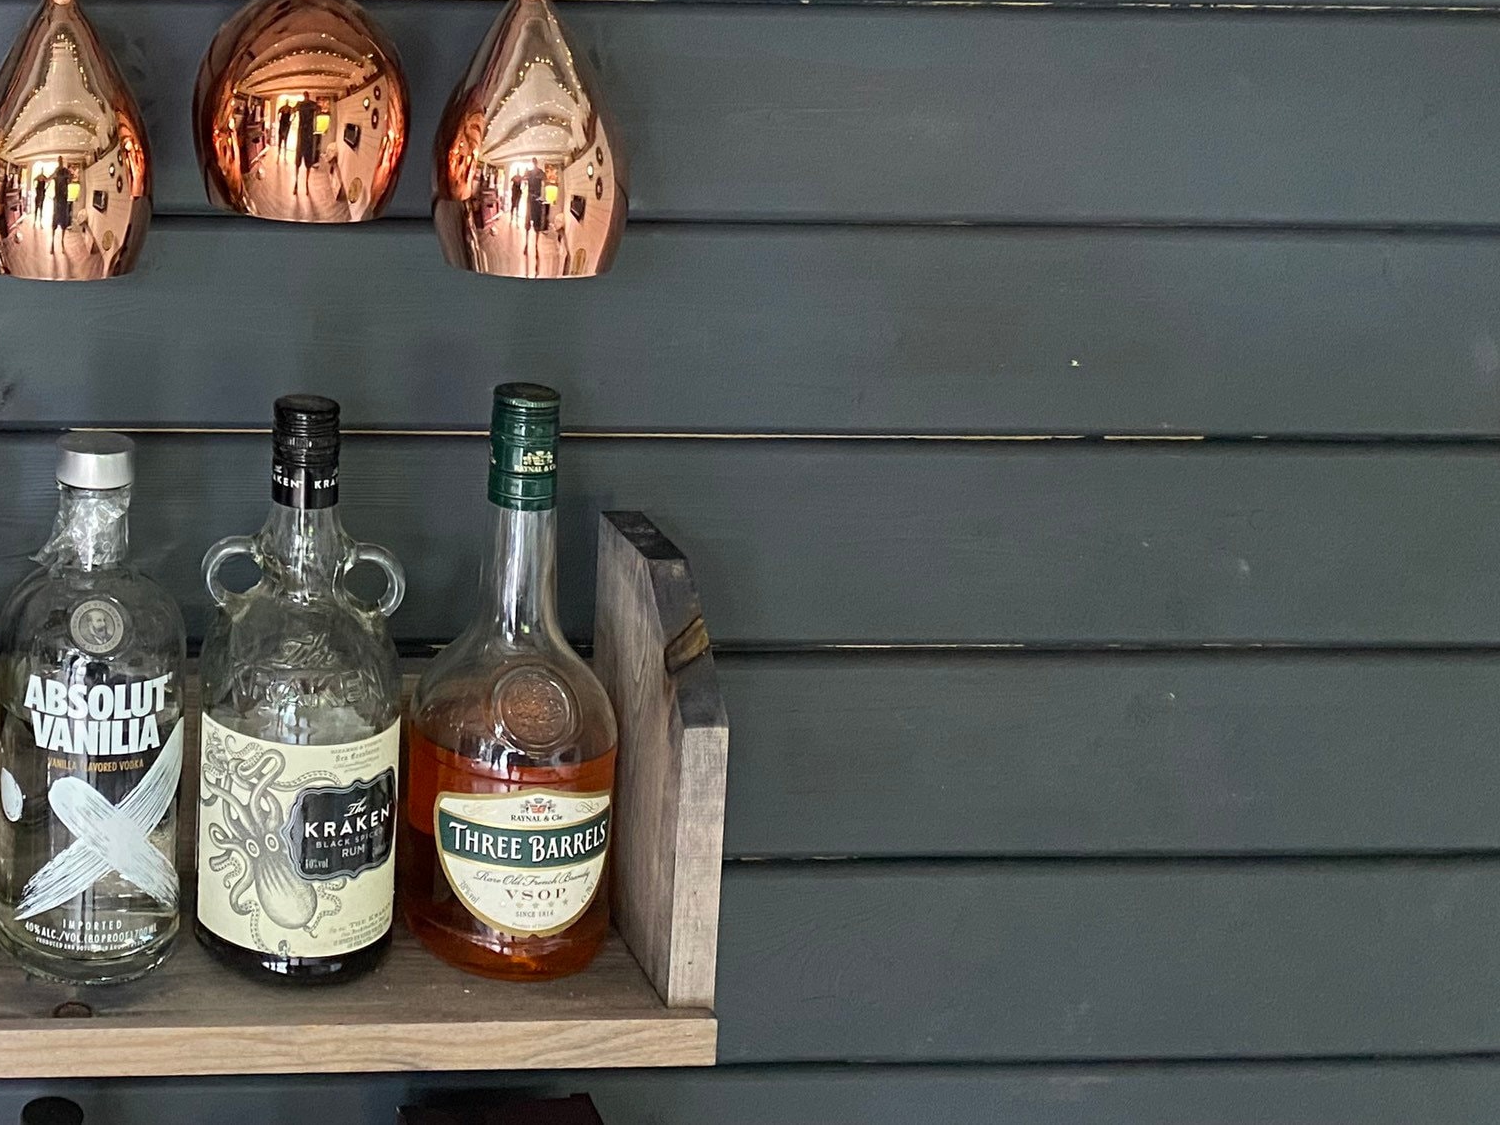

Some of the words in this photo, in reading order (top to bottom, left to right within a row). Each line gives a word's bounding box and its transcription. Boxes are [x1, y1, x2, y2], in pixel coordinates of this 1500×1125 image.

[23, 674, 169, 720] ABSOLUT
[31, 710, 161, 756] VANILIA
[119, 759, 144, 771] VODKA
[344, 797, 367, 817] The
[304, 804, 390, 838] KRAKEN
[510, 814, 541, 822] RAYNAL
[316, 839, 350, 848] BLACK
[449, 821, 522, 860] THREE
[528, 820, 606, 862] BARRELS
[342, 844, 365, 857] RUM
[502, 873, 521, 885] Old
[505, 888, 567, 901] VSOP
[63, 919, 122, 931] IMPORTED
